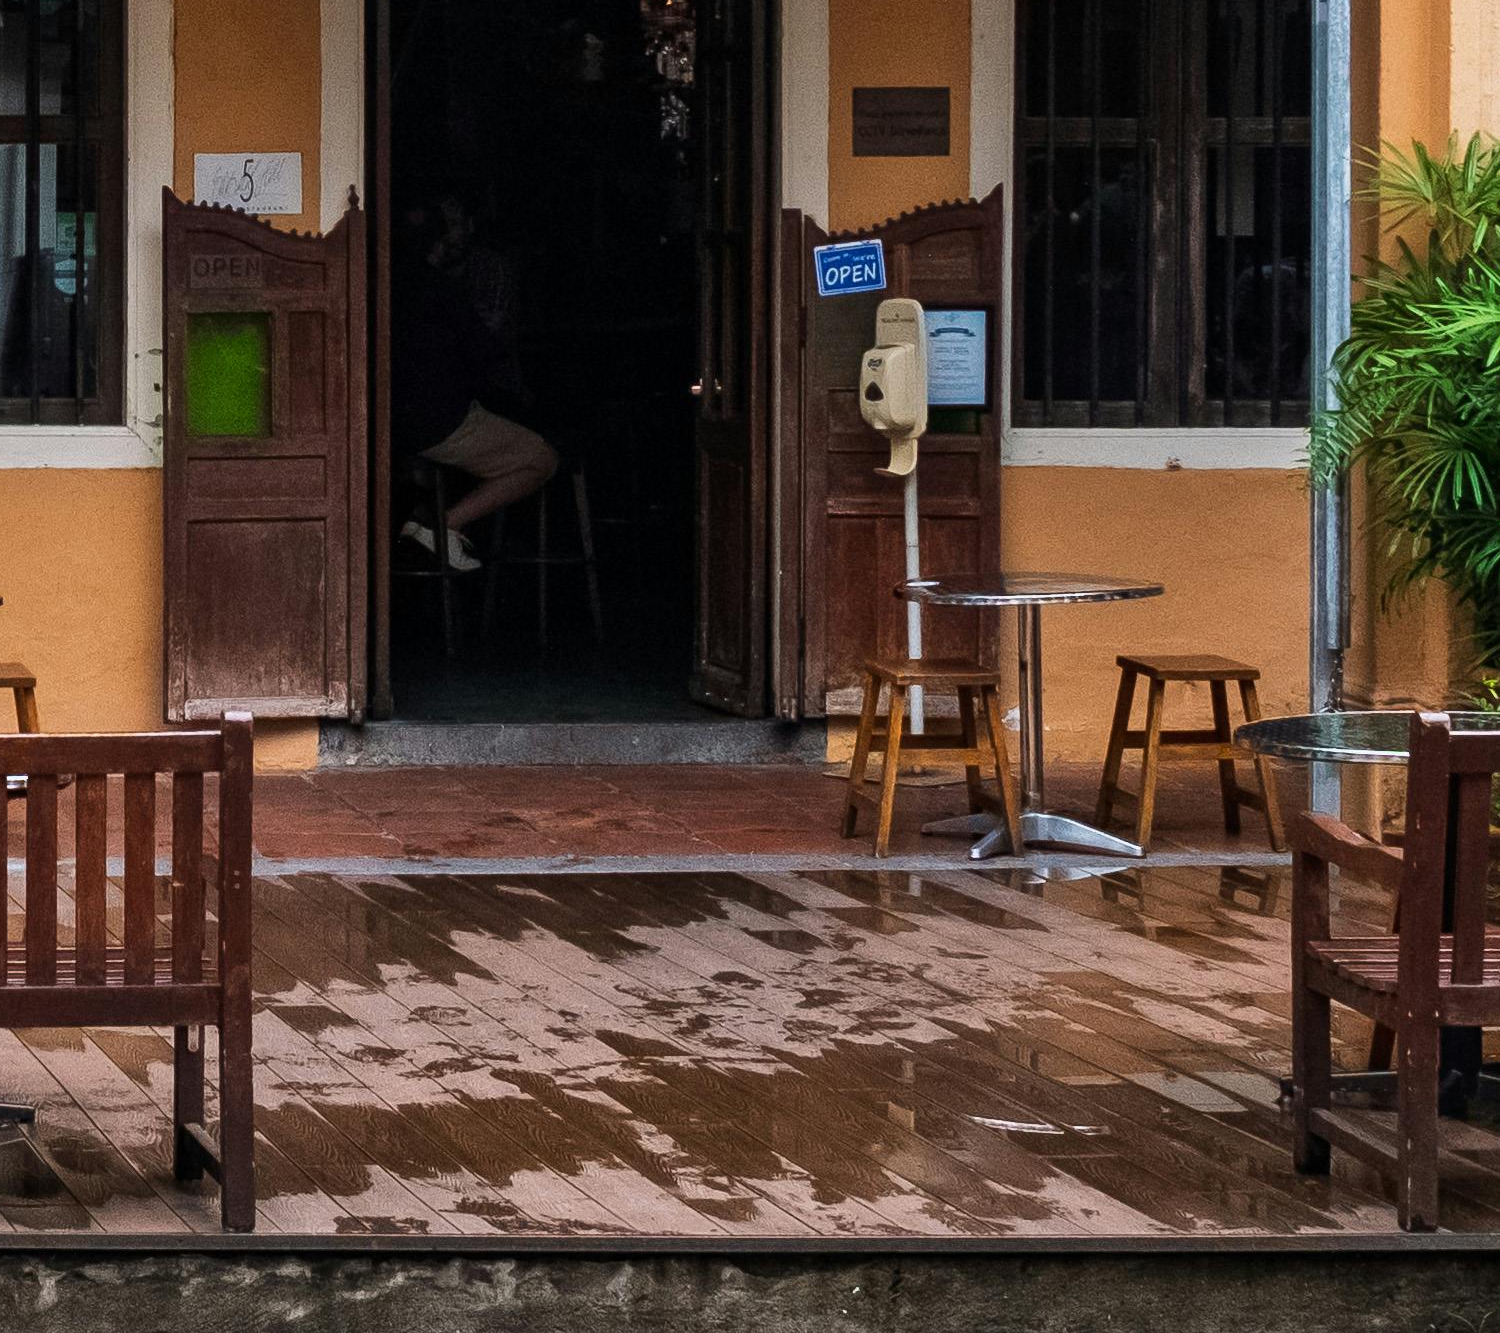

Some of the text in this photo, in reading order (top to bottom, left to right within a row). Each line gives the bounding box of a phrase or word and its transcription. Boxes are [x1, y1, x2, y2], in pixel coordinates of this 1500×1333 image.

[240, 159, 254, 202] 5
[193, 257, 259, 277] OPEN
[825, 262, 877, 286] OPEN
